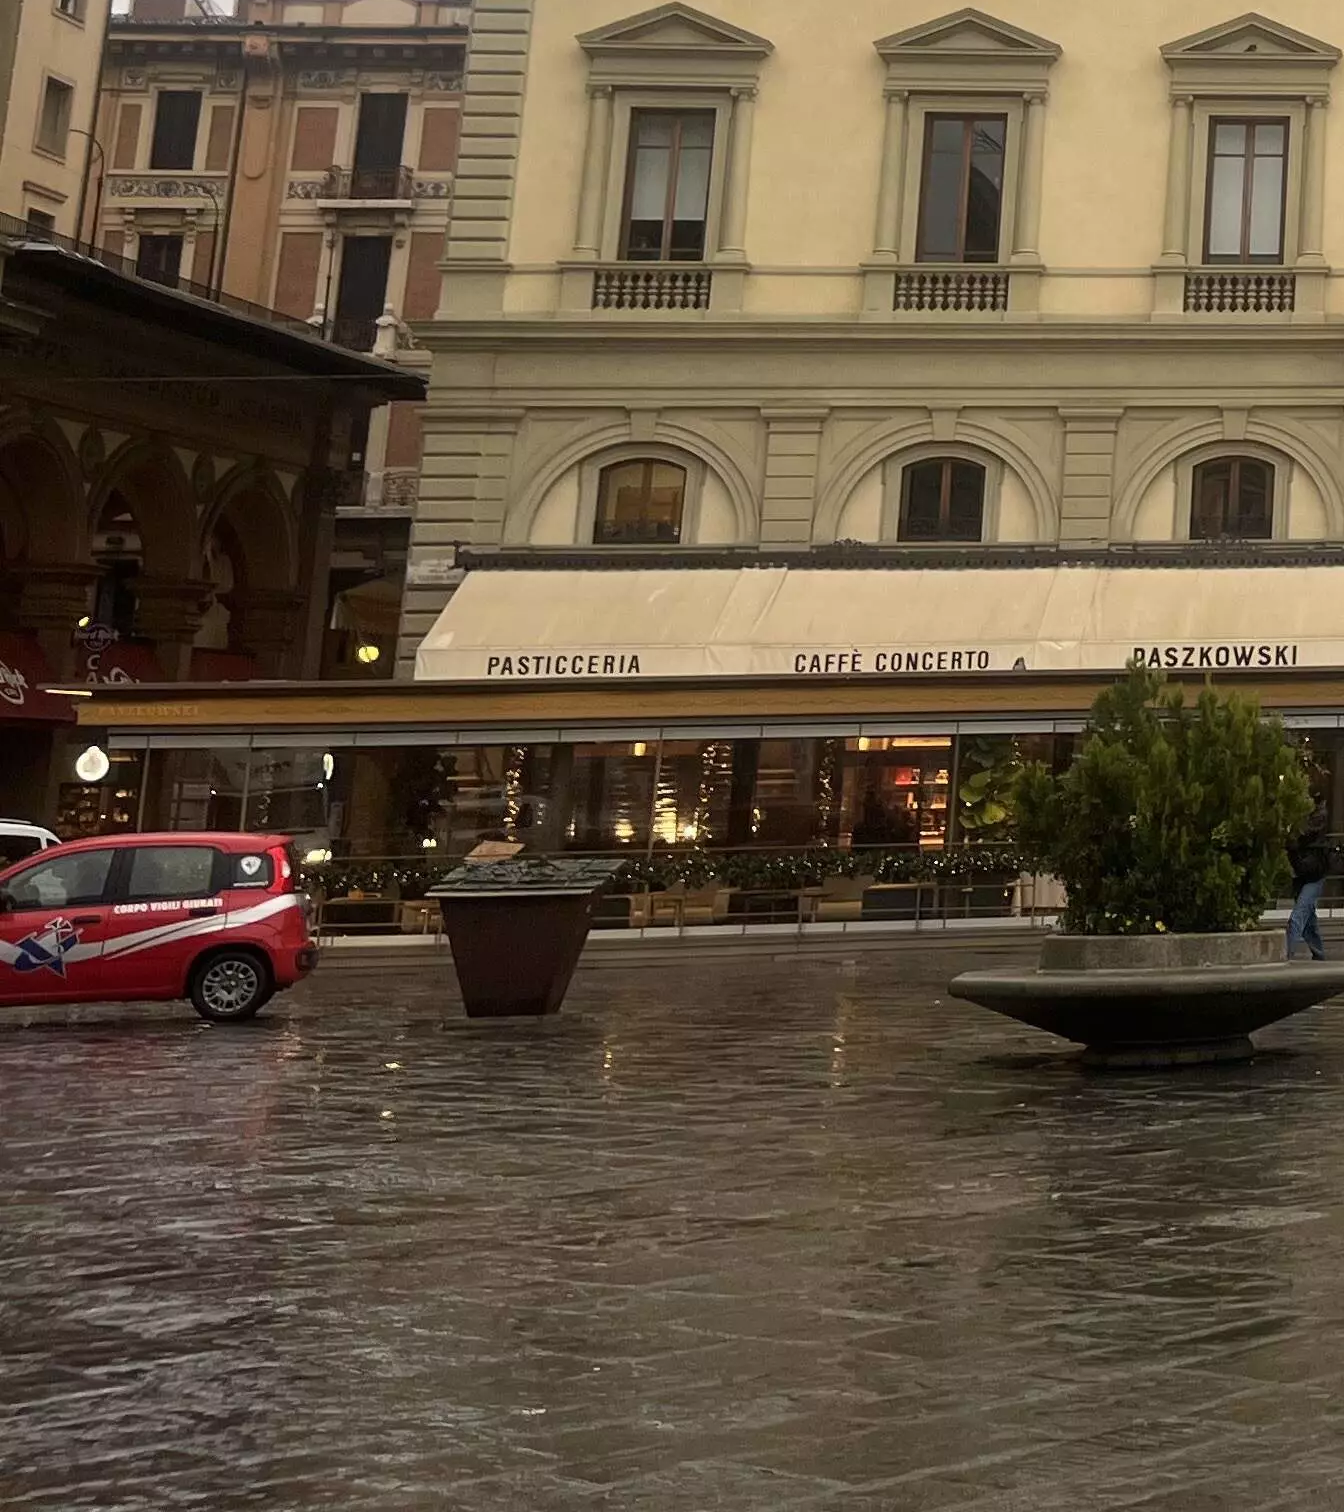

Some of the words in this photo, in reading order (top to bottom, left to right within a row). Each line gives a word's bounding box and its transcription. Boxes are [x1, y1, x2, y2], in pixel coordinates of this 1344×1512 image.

[487, 655, 641, 676] PASTICCERIA
[795, 648, 862, 674] CAFFÈ
[875, 650, 989, 673] CONCERTO
[1133, 645, 1298, 669] PASZKOWSKI
[113, 903, 148, 914] CORPO
[151, 900, 181, 911] VIGILI
